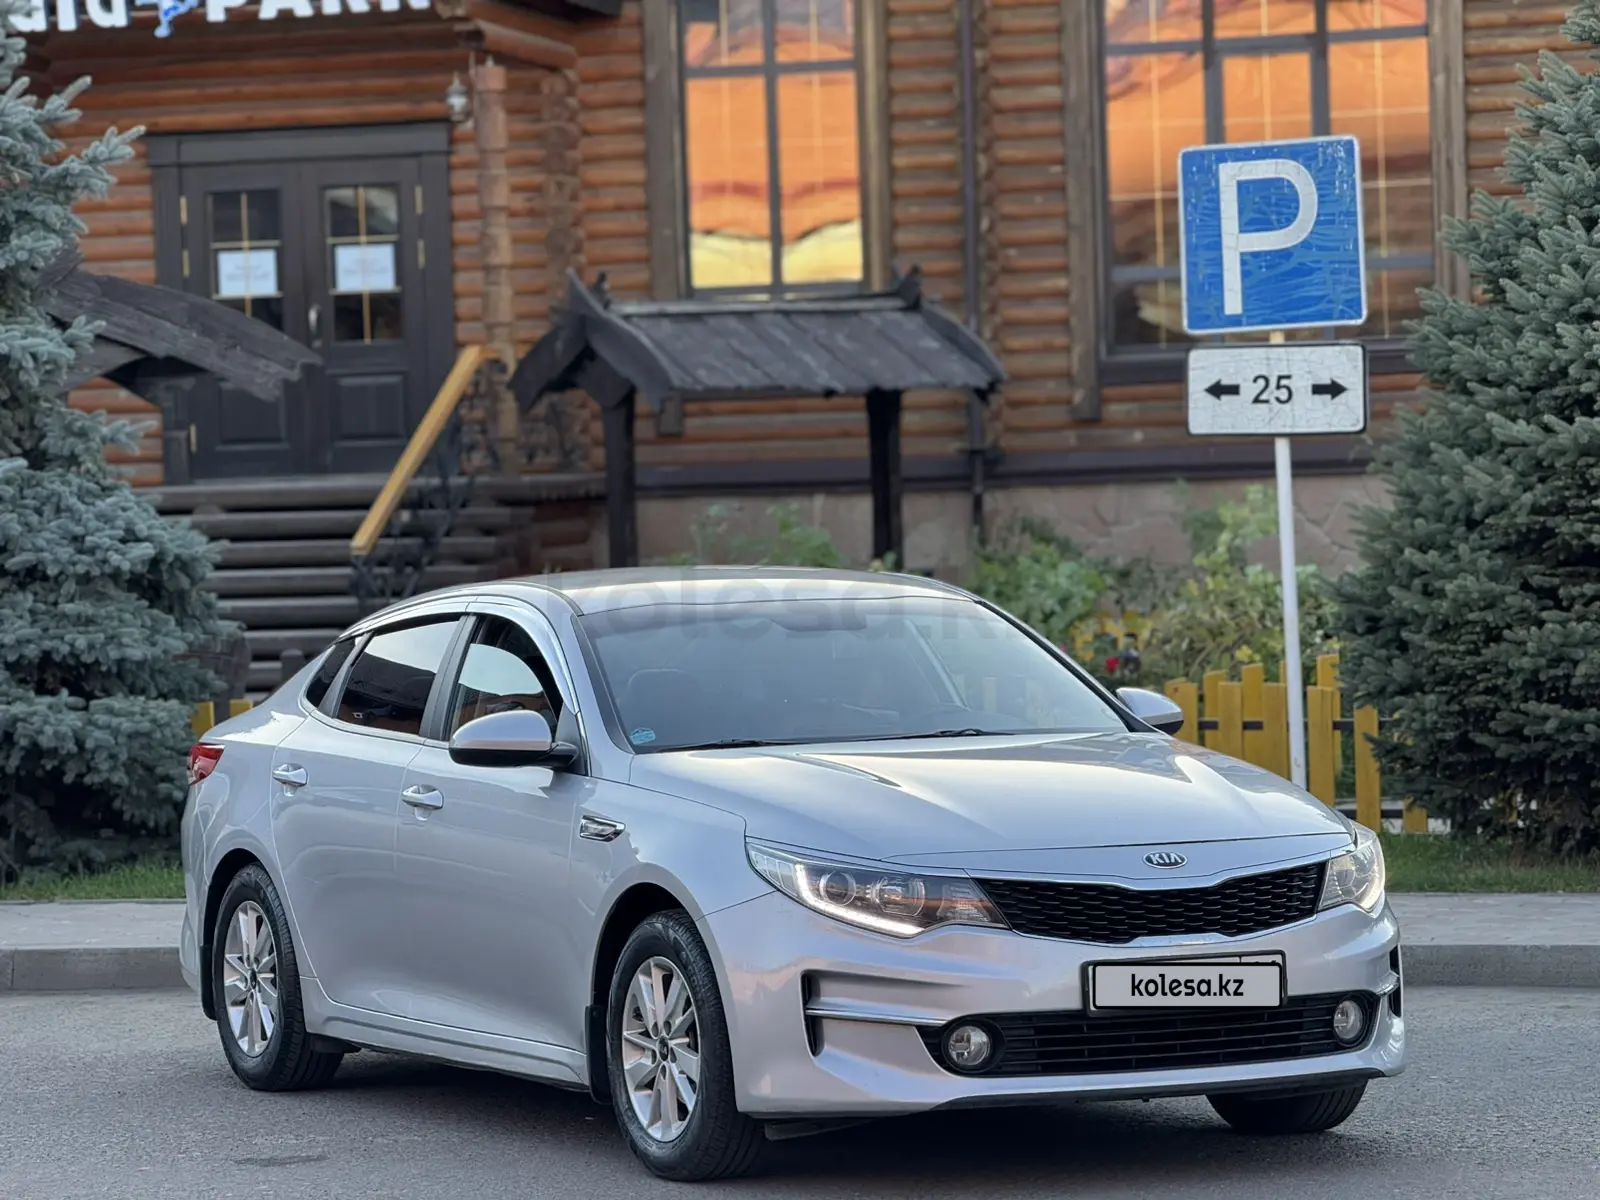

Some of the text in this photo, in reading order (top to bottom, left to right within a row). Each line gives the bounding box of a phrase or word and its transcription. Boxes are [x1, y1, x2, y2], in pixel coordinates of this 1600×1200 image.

[1219, 159, 1318, 315] P
[1252, 375, 1293, 404] 25
[1149, 852, 1182, 864] KIA
